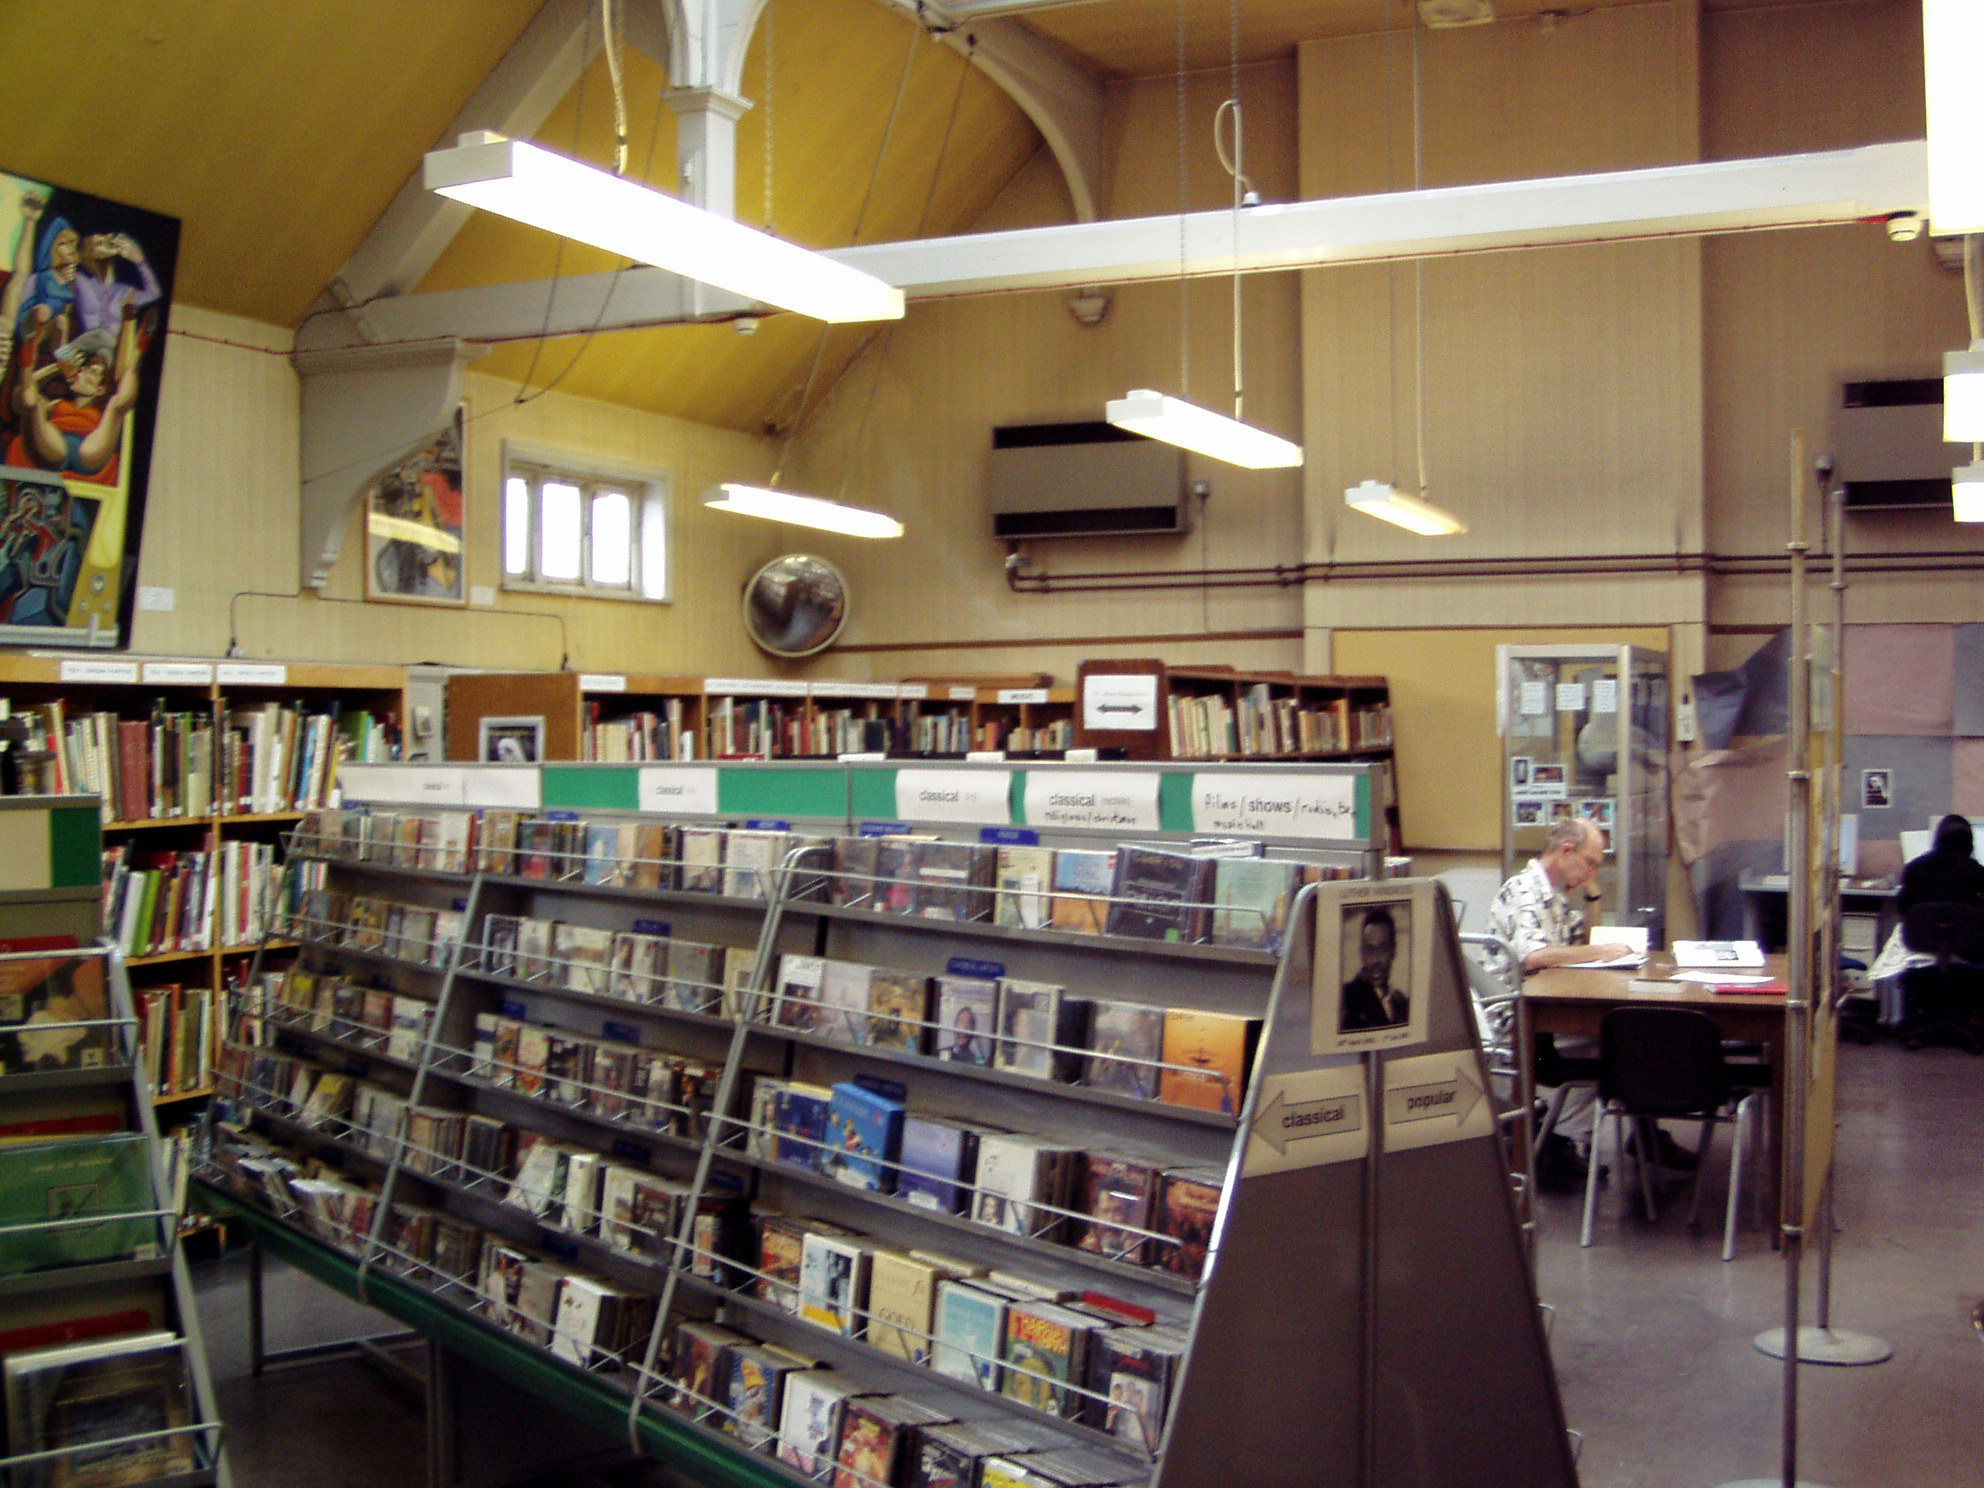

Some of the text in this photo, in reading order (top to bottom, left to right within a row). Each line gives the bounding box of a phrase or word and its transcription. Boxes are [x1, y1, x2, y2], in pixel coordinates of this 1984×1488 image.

[918, 790, 959, 803] classical
[1048, 792, 1096, 807] classical
[1407, 1090, 1457, 1114] popular
[1282, 1105, 1345, 1129] classical
